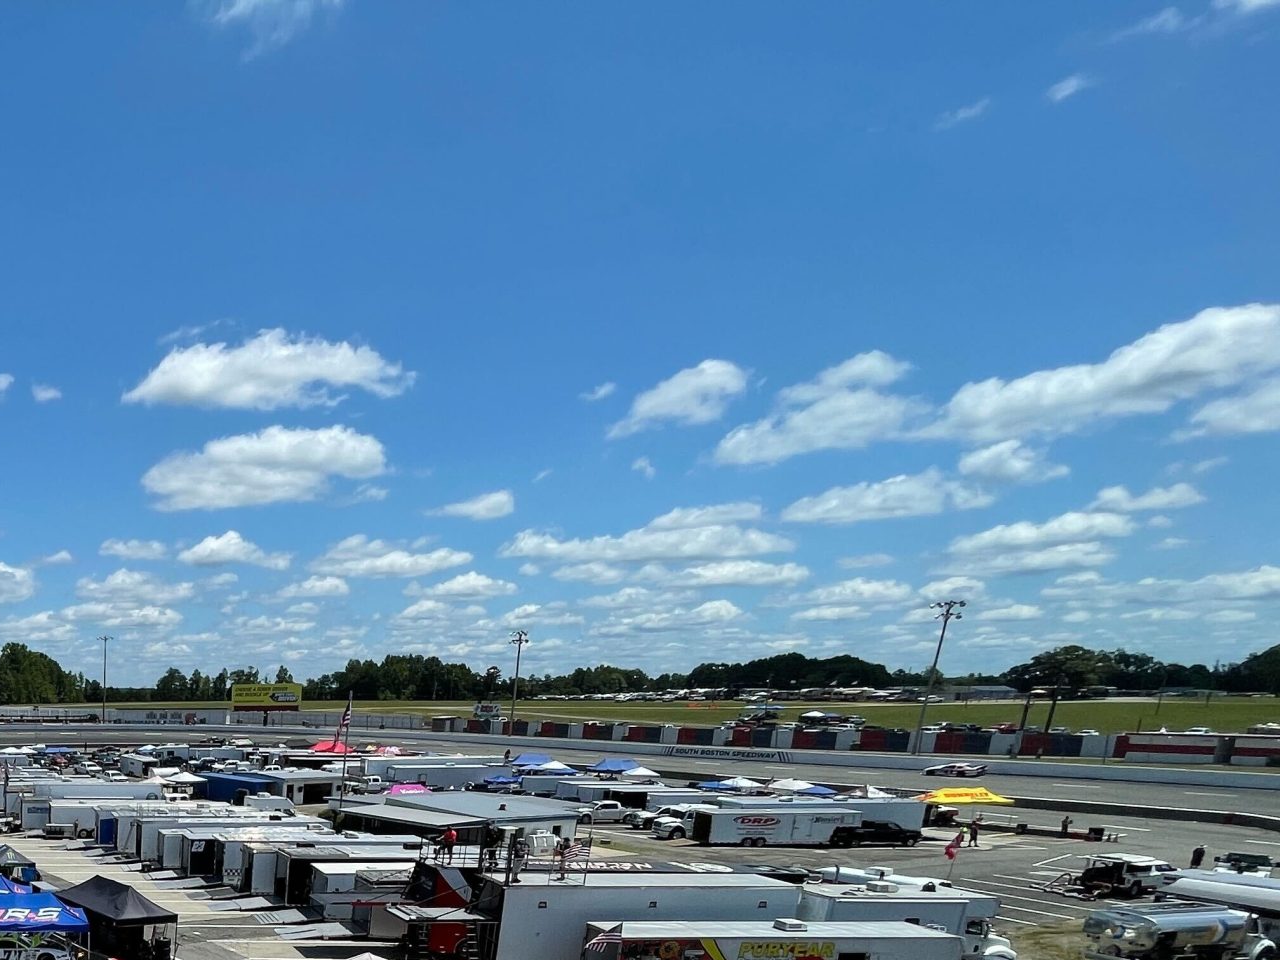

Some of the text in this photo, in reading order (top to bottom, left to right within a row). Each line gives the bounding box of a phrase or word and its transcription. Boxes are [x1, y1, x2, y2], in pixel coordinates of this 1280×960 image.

[700, 749, 730, 757] BOSTON
[731, 751, 777, 759] SPEEDWAY
[738, 942, 835, 958] PURYEAR
